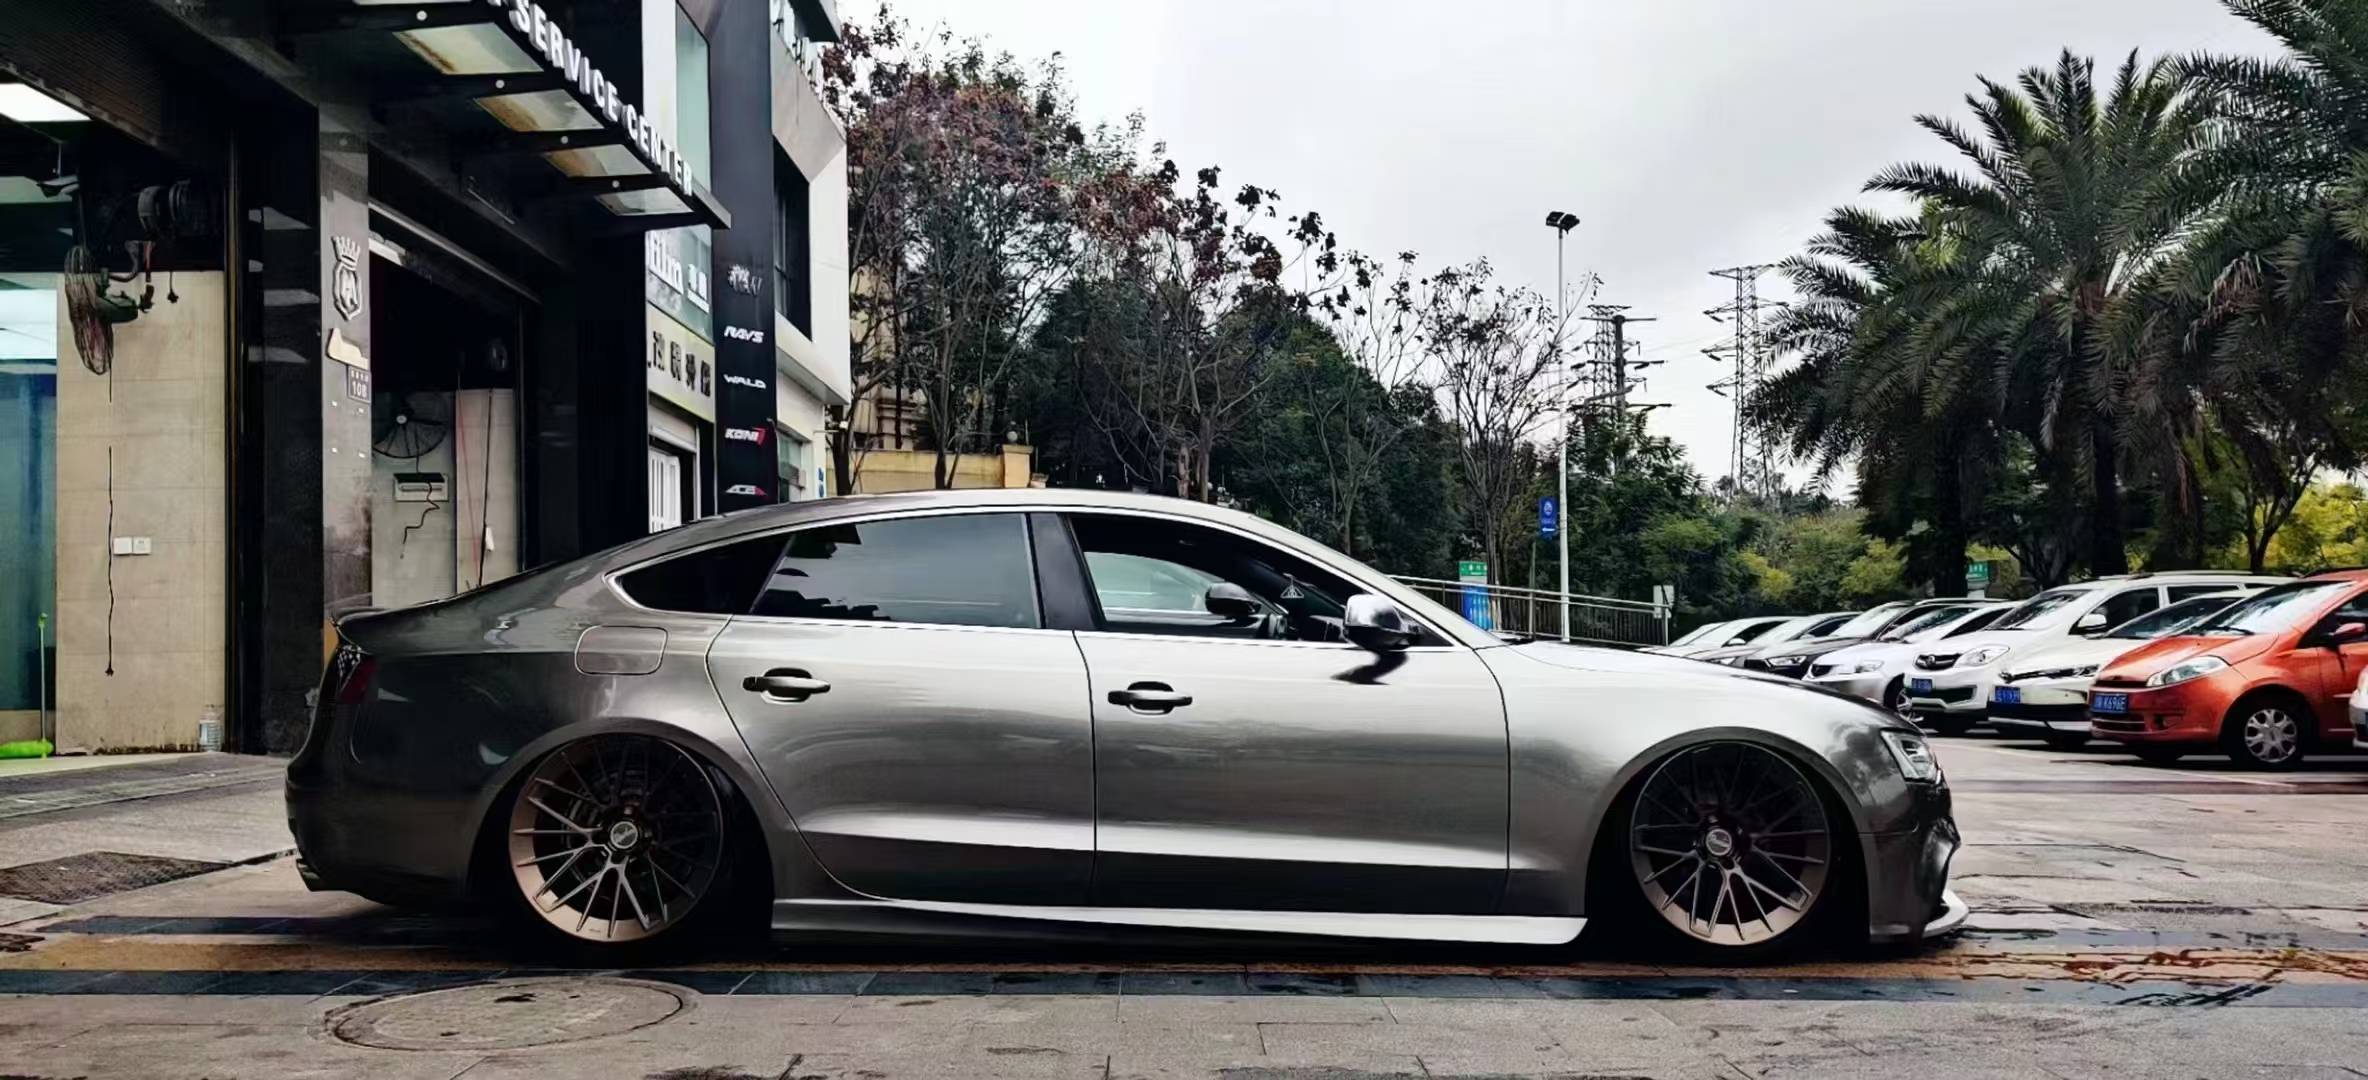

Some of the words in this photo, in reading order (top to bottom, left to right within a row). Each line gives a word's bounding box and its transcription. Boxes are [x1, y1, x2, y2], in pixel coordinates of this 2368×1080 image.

[509, 0, 620, 122] SERVICE
[622, 103, 693, 196] CENTER
[724, 326, 764, 343] RAYS
[723, 373, 766, 389] WALD
[725, 428, 760, 442] KONI
